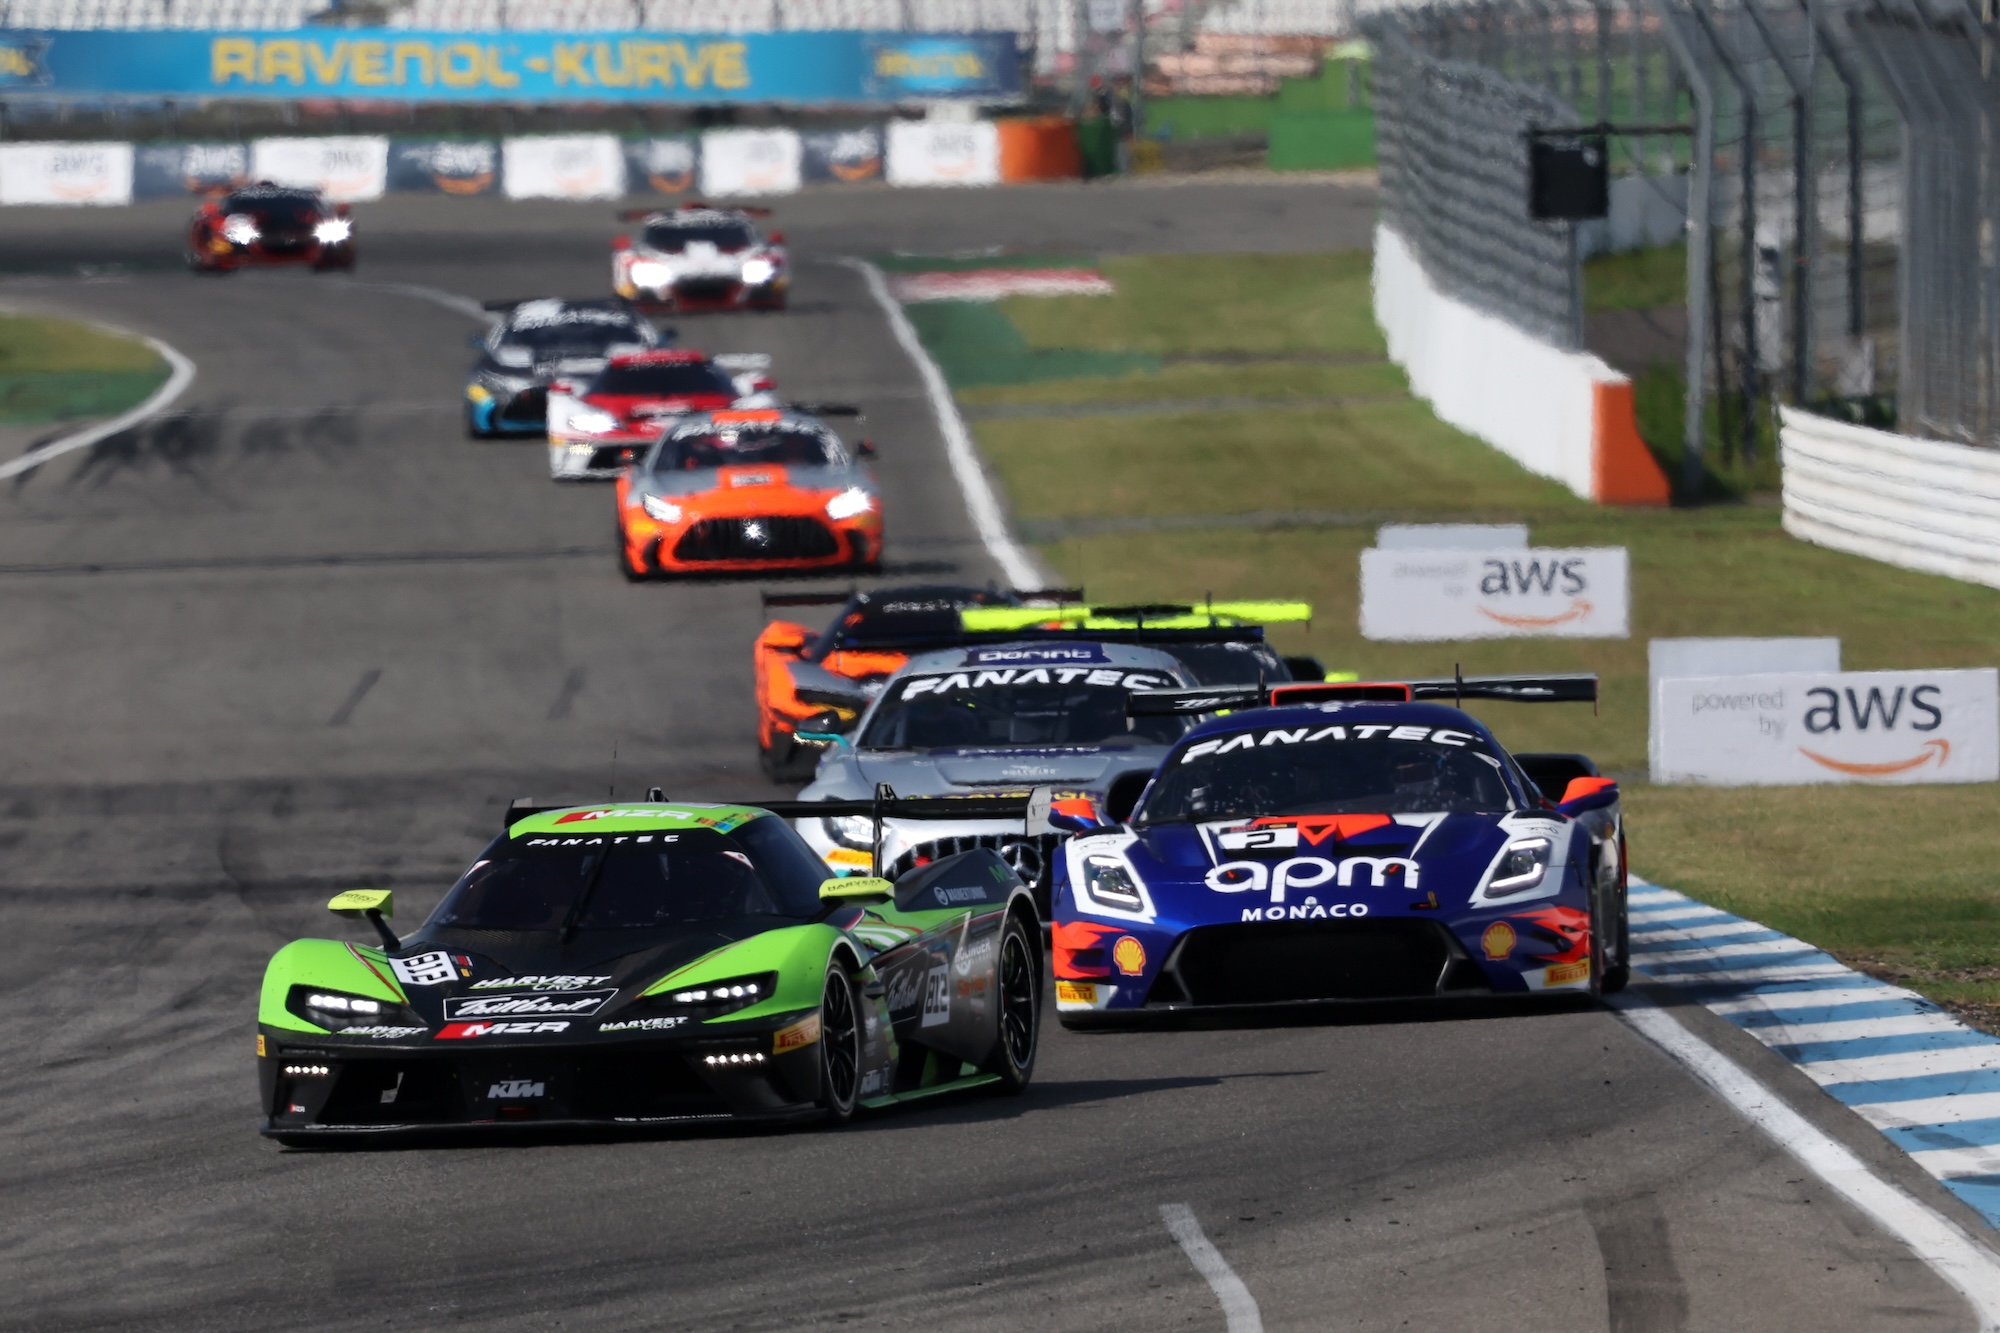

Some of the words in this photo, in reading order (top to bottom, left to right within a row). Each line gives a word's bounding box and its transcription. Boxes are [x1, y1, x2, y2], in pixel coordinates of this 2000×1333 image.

[1480, 557, 1587, 595] aws
[901, 668, 1162, 701] FANATEC
[1692, 687, 1784, 715] powered
[1804, 684, 1942, 734] aws
[1180, 725, 1474, 764] FANATEC
[581, 809, 694, 820] MZR
[526, 834, 680, 846] FANATEC
[1245, 832, 1275, 848] 2
[1204, 857, 1420, 902] apm
[1241, 903, 1369, 922] MONACO
[402, 952, 450, 982] 912
[1551, 962, 1589, 982] PIRELLI
[472, 975, 612, 988] HARVEST
[1058, 985, 1093, 1000] PIRELLI
[461, 1021, 571, 1036] MZR
[599, 1016, 689, 1030] HARVEST
[487, 1079, 545, 1098] KTM
